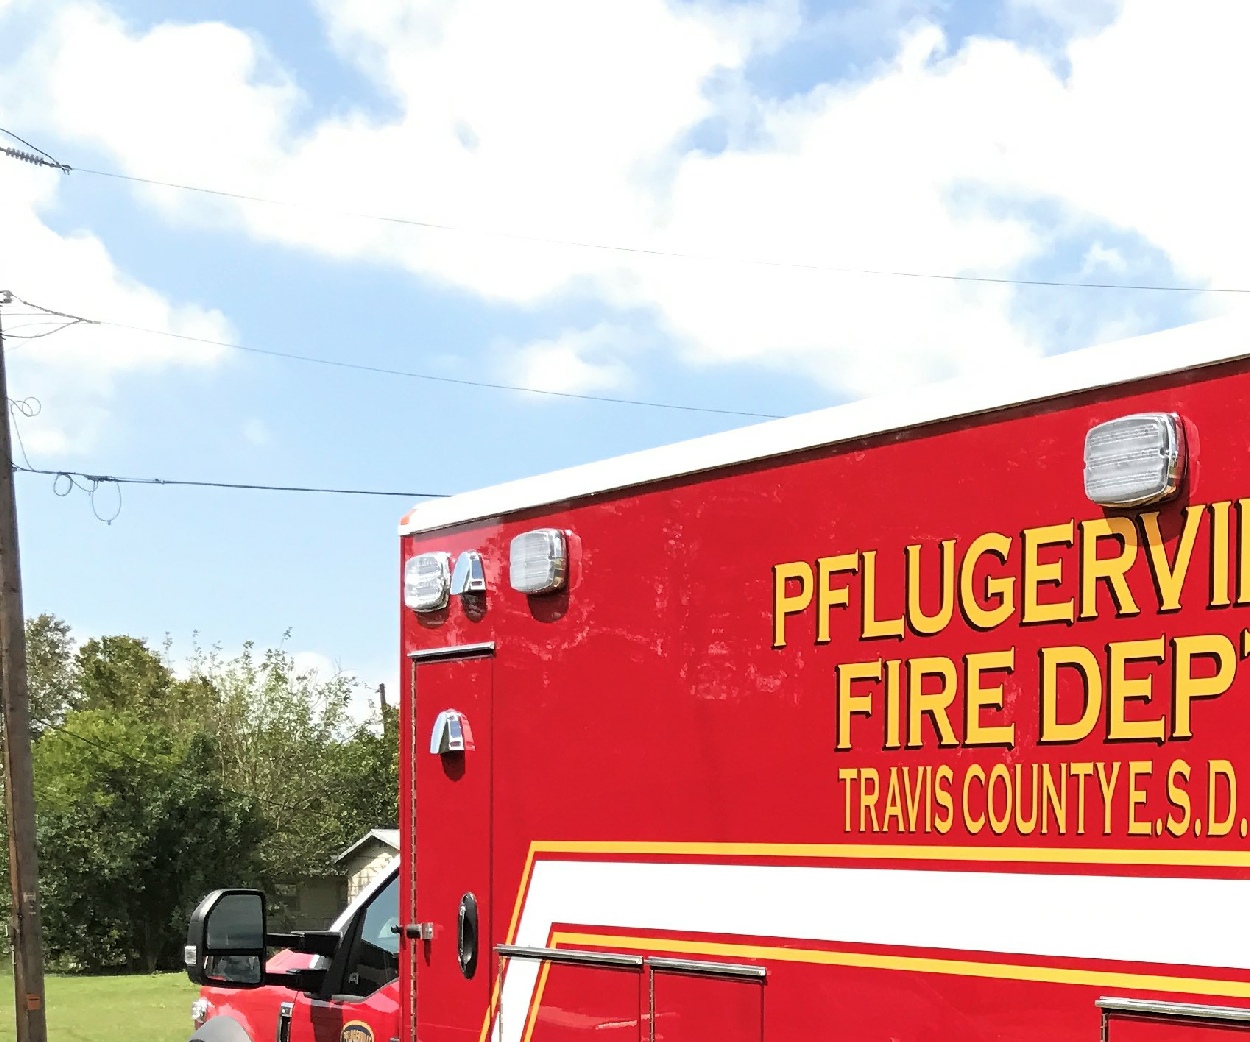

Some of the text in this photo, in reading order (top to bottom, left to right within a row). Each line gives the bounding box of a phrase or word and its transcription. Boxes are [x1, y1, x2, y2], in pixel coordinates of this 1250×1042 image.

[835, 648, 1016, 752] FIRE
[838, 763, 953, 835] TRAVIS
[962, 760, 1121, 837] COUNTY
[1127, 758, 1249, 838] E.S.D.
